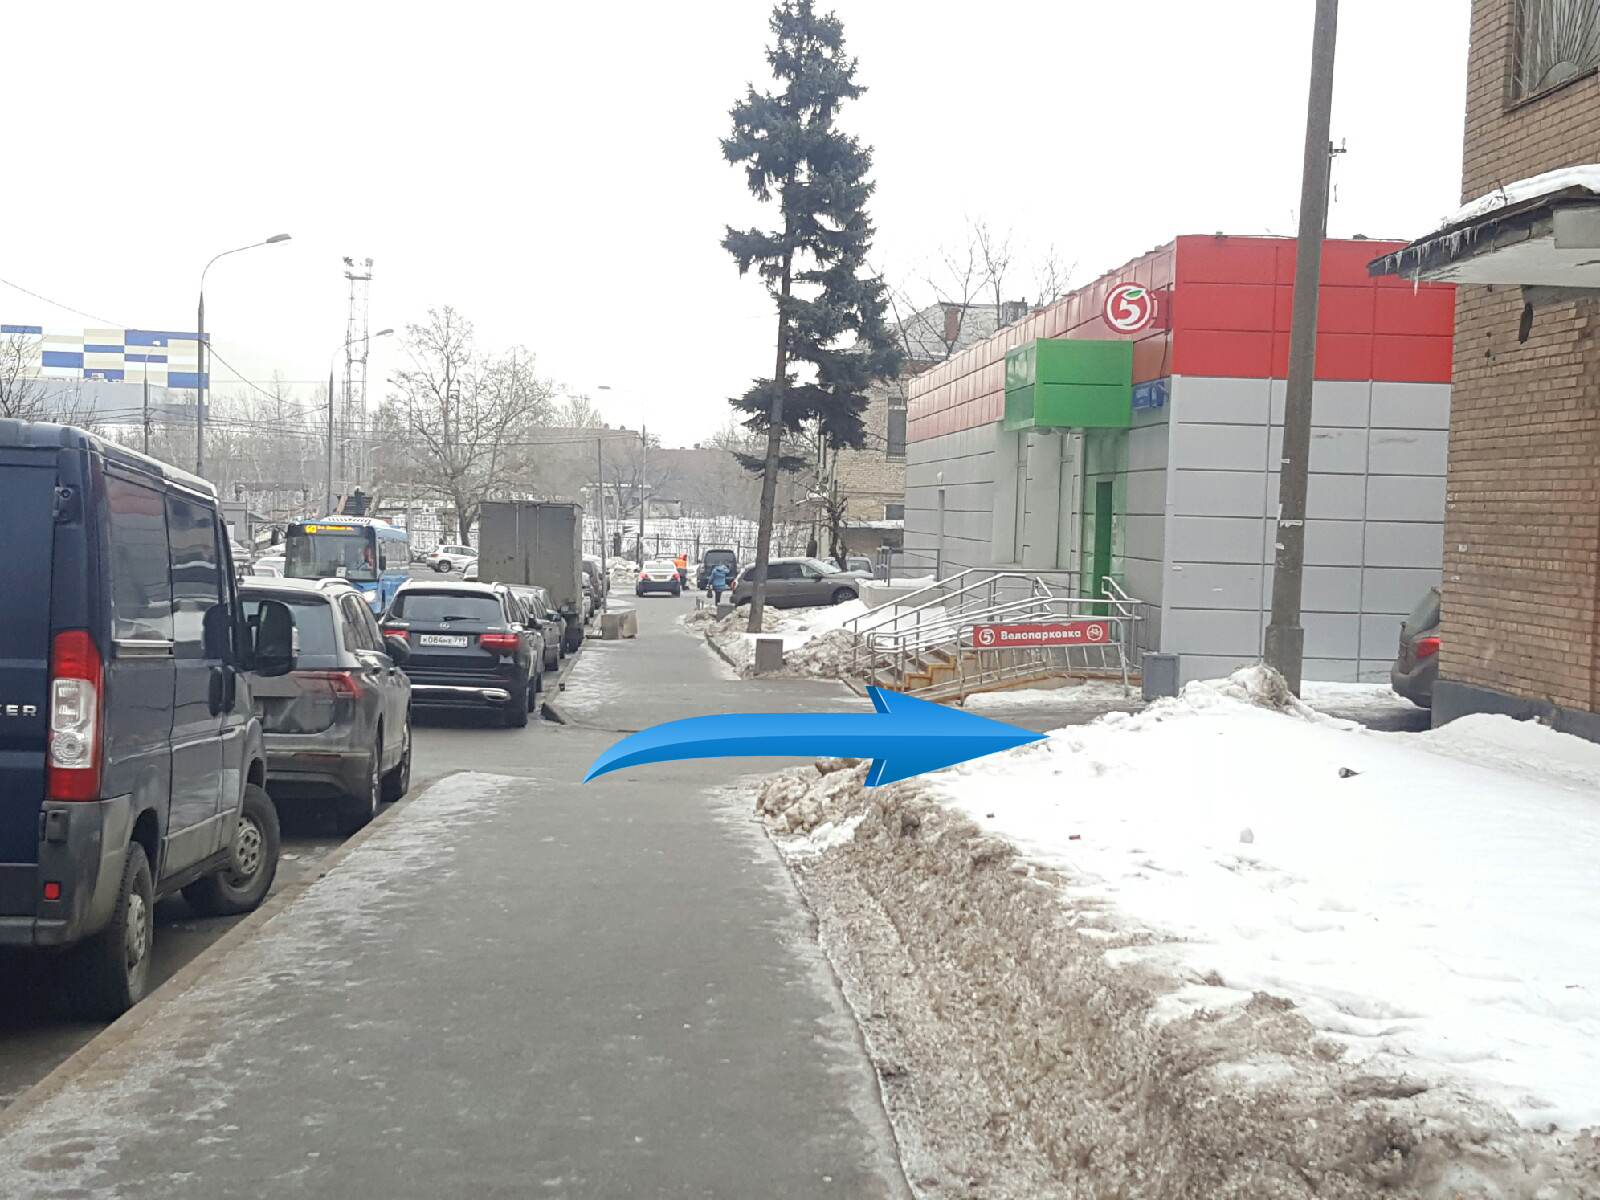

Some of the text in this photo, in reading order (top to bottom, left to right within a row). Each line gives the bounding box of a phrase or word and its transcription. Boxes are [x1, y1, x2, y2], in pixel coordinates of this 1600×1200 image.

[1115, 293, 1143, 327] 5
[1000, 629, 1081, 641] Велопарковка
[0, 704, 37, 716] ER
